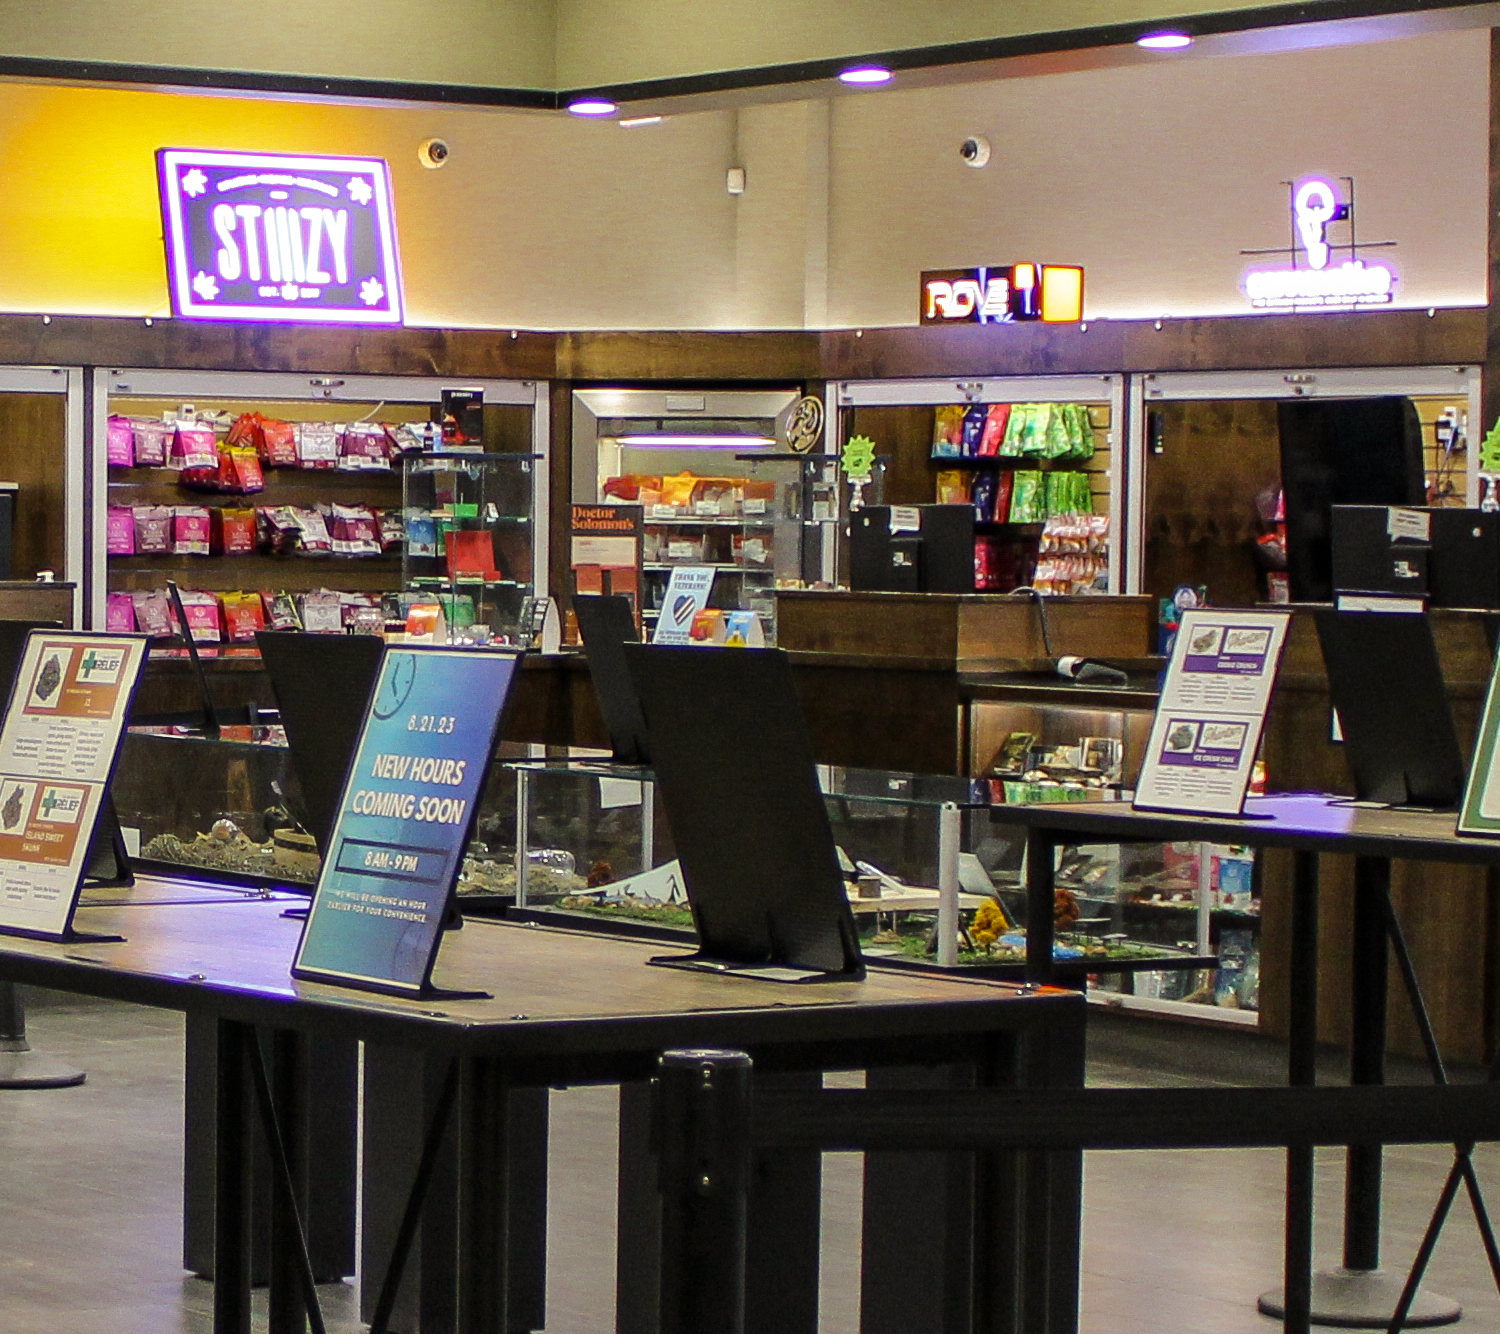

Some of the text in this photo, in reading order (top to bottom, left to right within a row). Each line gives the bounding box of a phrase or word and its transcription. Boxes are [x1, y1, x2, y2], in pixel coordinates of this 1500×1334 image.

[925, 278, 1010, 319] ROVE
[571, 506, 616, 519] Doctor
[570, 518, 635, 531] Solomon's
[406, 714, 456, 734] 8.21.23
[371, 753, 467, 786] NEW HOURS
[351, 789, 467, 826] COMING SOON
[363, 850, 373, 866] 8
[372, 851, 389, 869] AM
[393, 853, 404, 870] 9
[401, 854, 420, 872] PM
